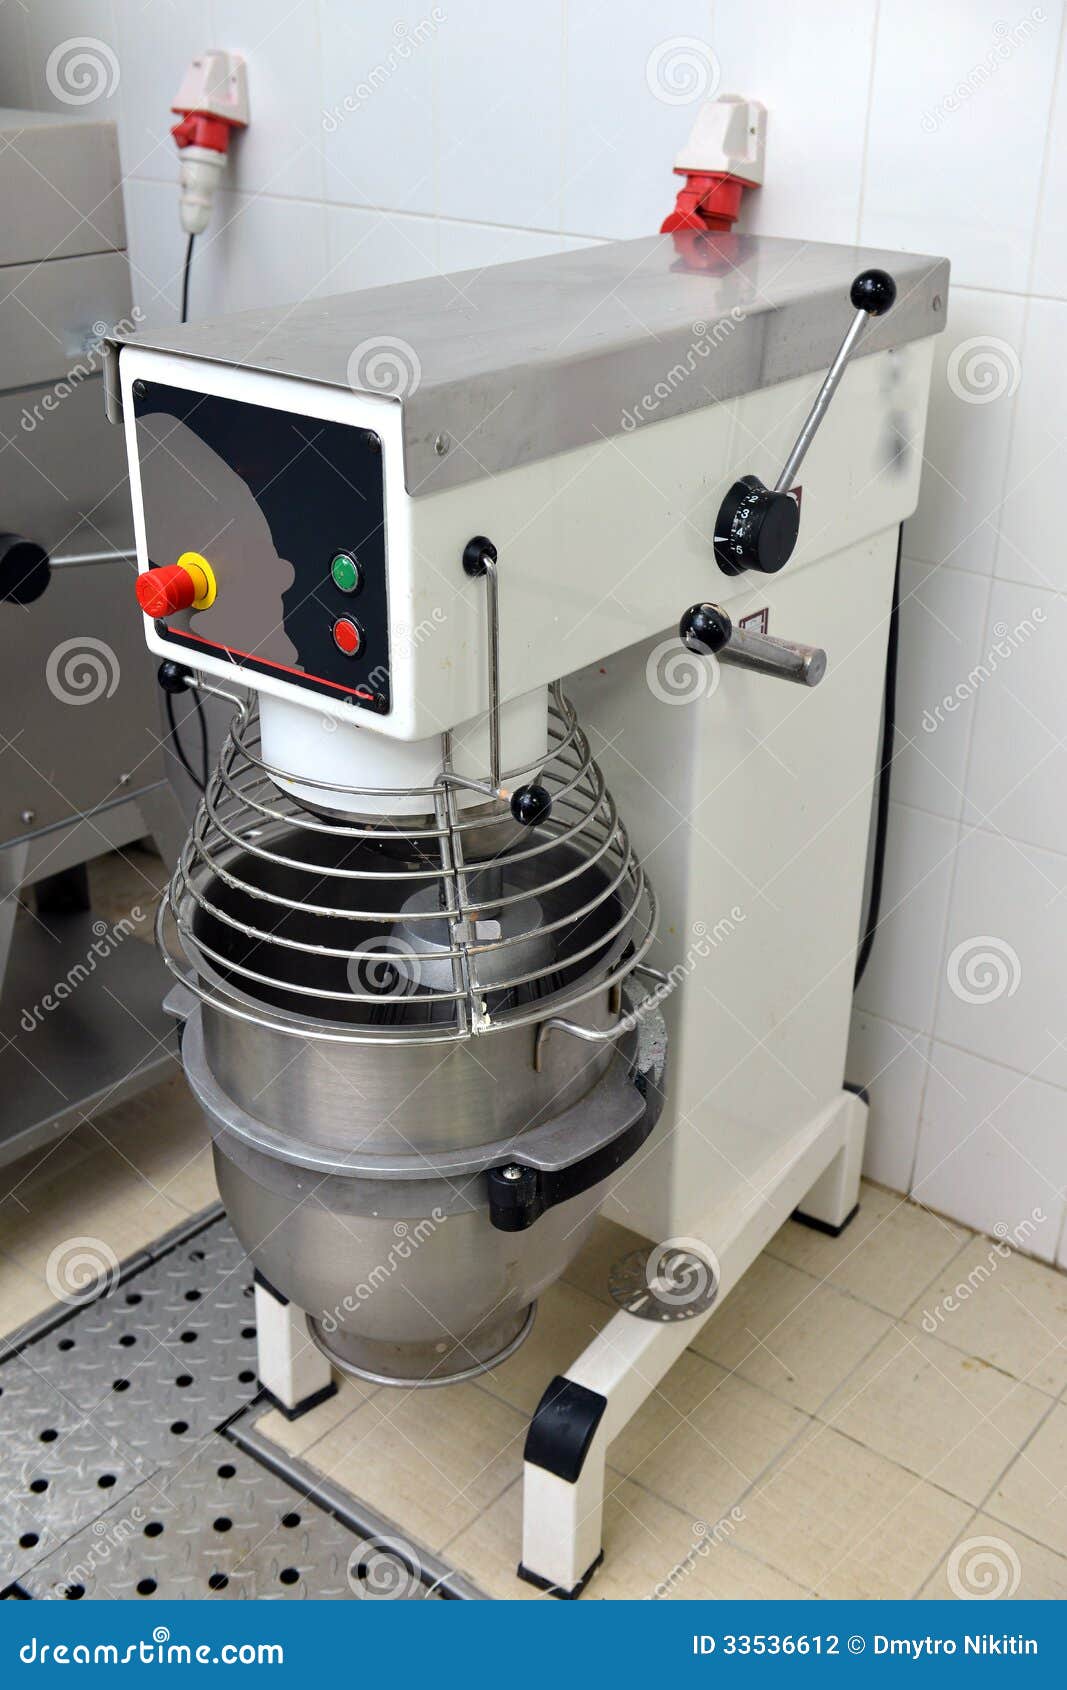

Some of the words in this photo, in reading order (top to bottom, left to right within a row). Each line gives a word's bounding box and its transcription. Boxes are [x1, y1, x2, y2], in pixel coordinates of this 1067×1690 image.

[748, 495, 759, 503] 2
[741, 508, 750, 519] 3
[736, 527, 744, 538] 4
[736, 545, 743, 555] 5
